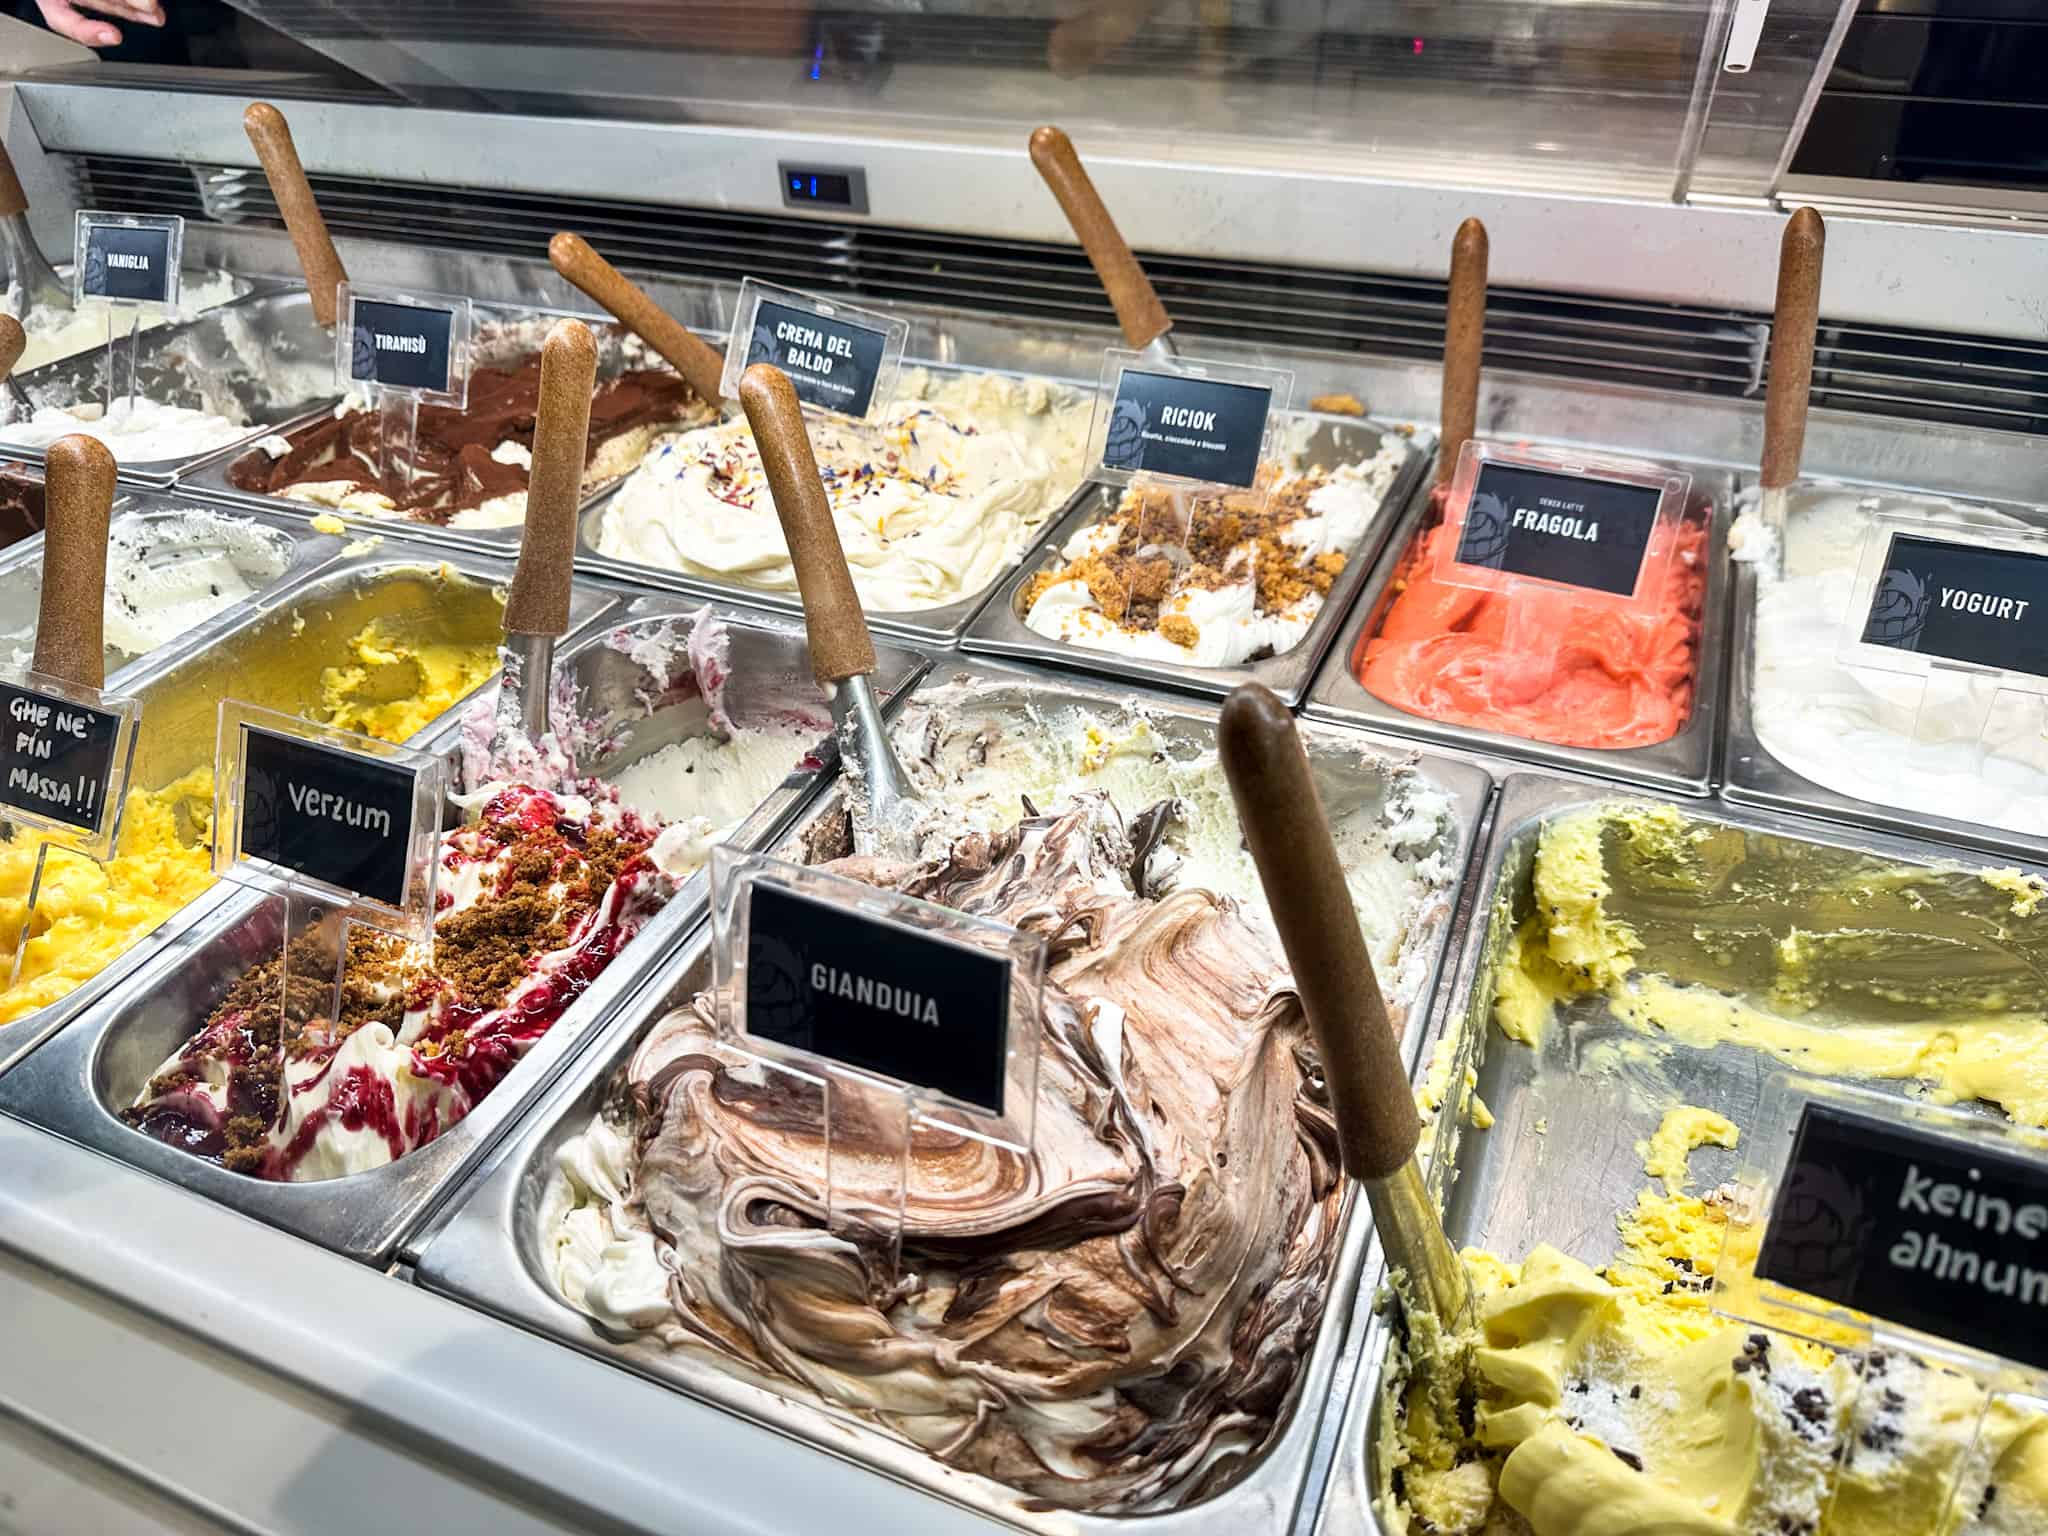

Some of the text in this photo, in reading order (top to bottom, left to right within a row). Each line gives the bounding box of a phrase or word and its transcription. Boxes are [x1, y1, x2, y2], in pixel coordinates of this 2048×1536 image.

[107, 253, 149, 270] VANIGLIA
[374, 333, 426, 354] TIRAMISÙ
[776, 321, 853, 358] CREMA DEL
[787, 348, 833, 375] BALDO
[1161, 406, 1217, 432] RICIOK
[1562, 501, 1585, 513] LATTE
[1512, 508, 1599, 542] FRAGOLA
[1940, 587, 2029, 621] YOGURT
[811, 962, 940, 1027] GIANDUIA
[1898, 1164, 2048, 1240] keine
